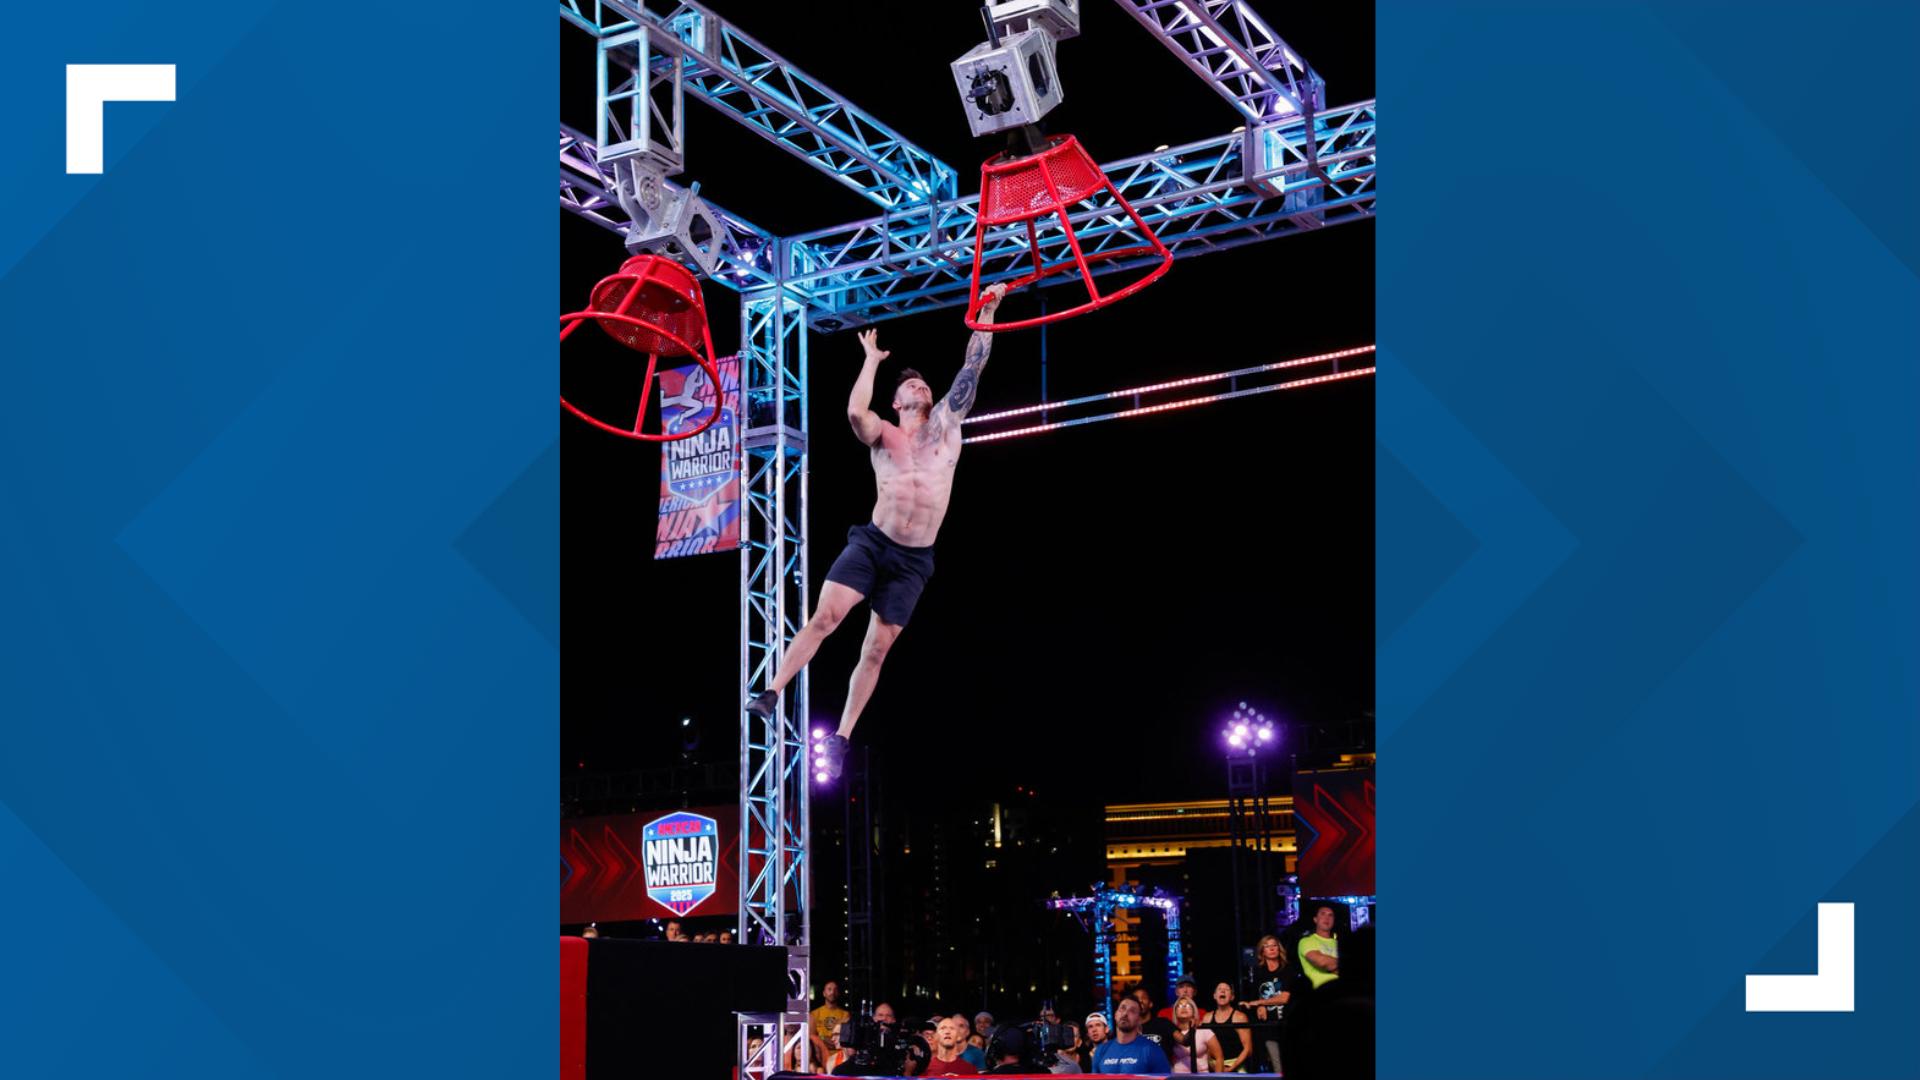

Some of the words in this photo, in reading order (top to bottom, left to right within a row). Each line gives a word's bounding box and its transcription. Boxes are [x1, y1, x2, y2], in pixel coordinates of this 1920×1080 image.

[671, 426, 731, 460] NINJA
[671, 451, 731, 480] WARRIOR
[646, 835, 713, 865] NINJA
[647, 861, 713, 887] WARRIOR
[670, 889, 693, 902] 2025
